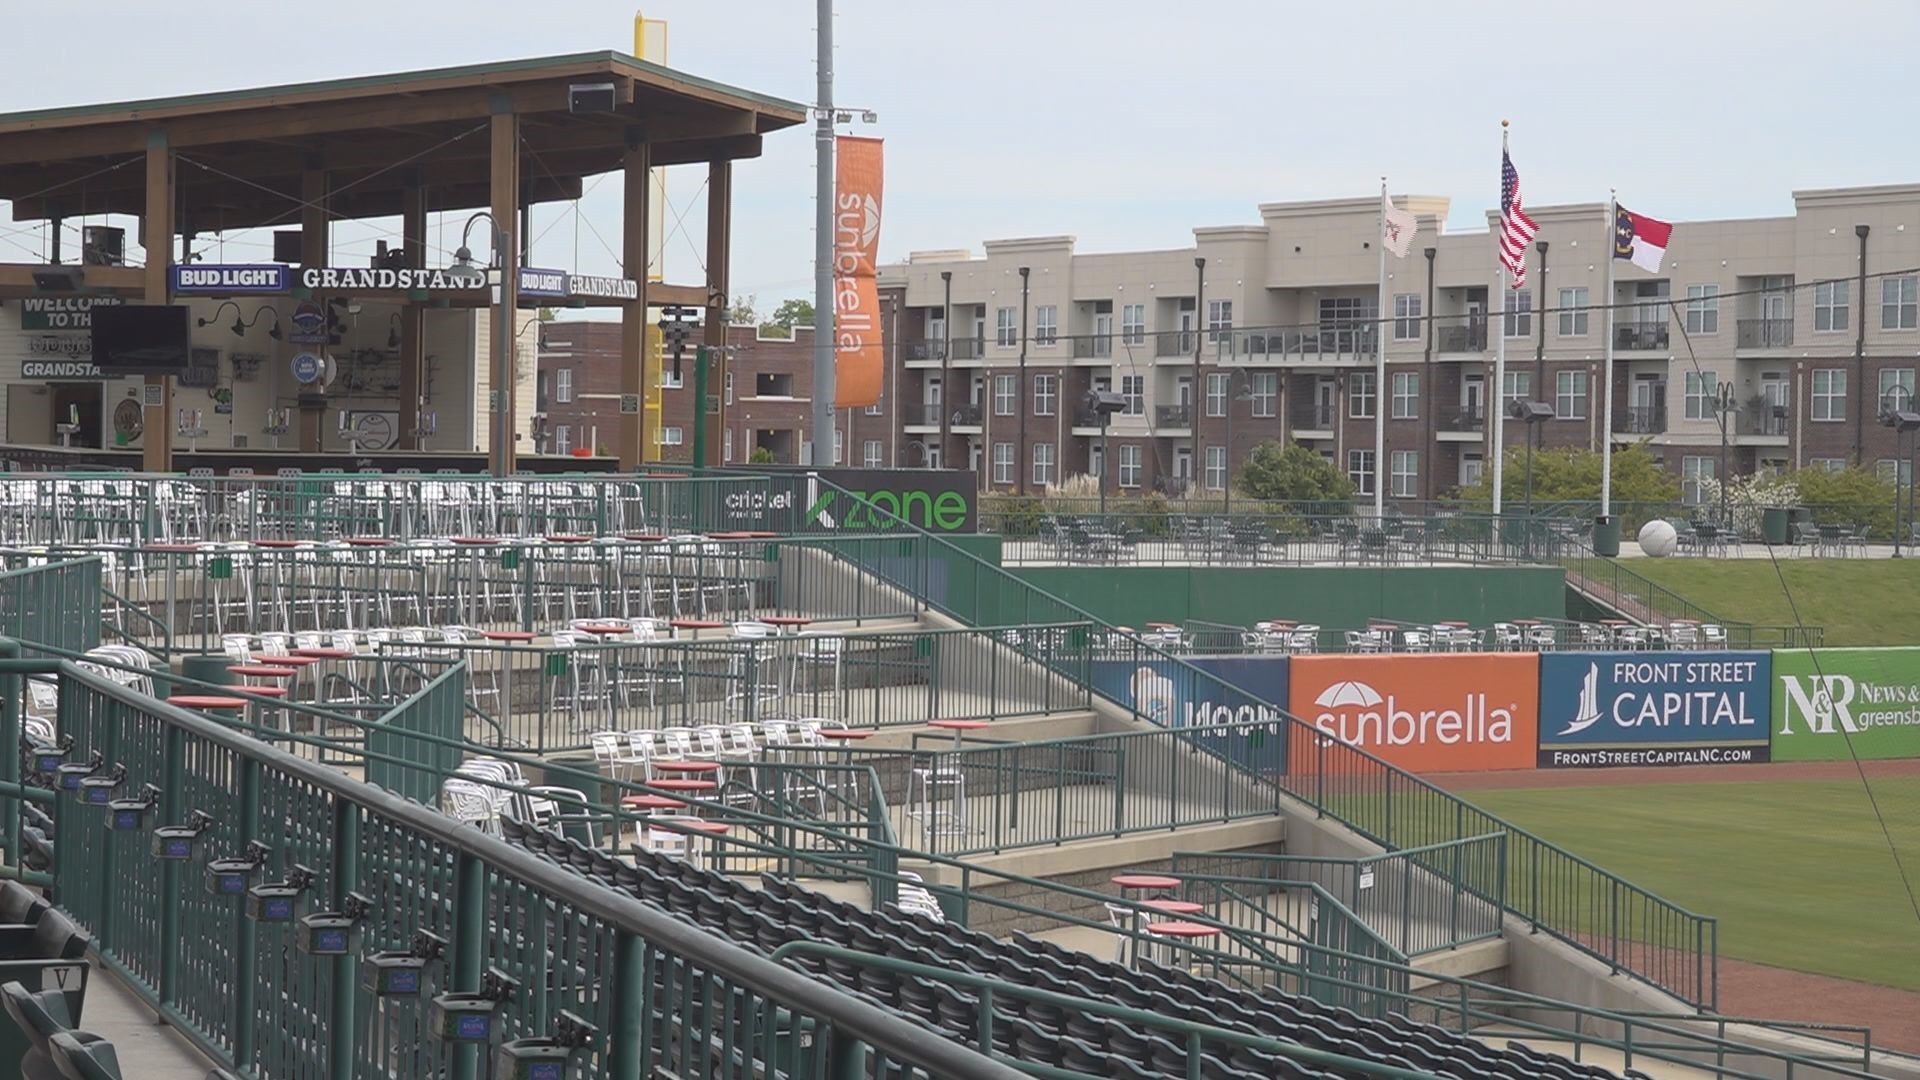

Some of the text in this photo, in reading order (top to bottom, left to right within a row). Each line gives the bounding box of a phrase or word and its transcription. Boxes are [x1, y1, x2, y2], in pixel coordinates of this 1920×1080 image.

[181, 269, 278, 286] BUD LIGHT
[303, 268, 486, 289] GRANDSTAND
[521, 273, 562, 291] BUD LIGHT
[837, 193, 871, 353] sunbrella
[569, 275, 638, 299] GRANDSTAND
[47, 313, 92, 327] TO TH
[843, 490, 968, 530] zone
[1613, 661, 1757, 684] FRONT STREET
[1860, 682, 1906, 704] NEWS
[1314, 693, 1513, 748] sunbrella
[1612, 691, 1755, 727] CAPITAL
[53, 967, 71, 990] V
